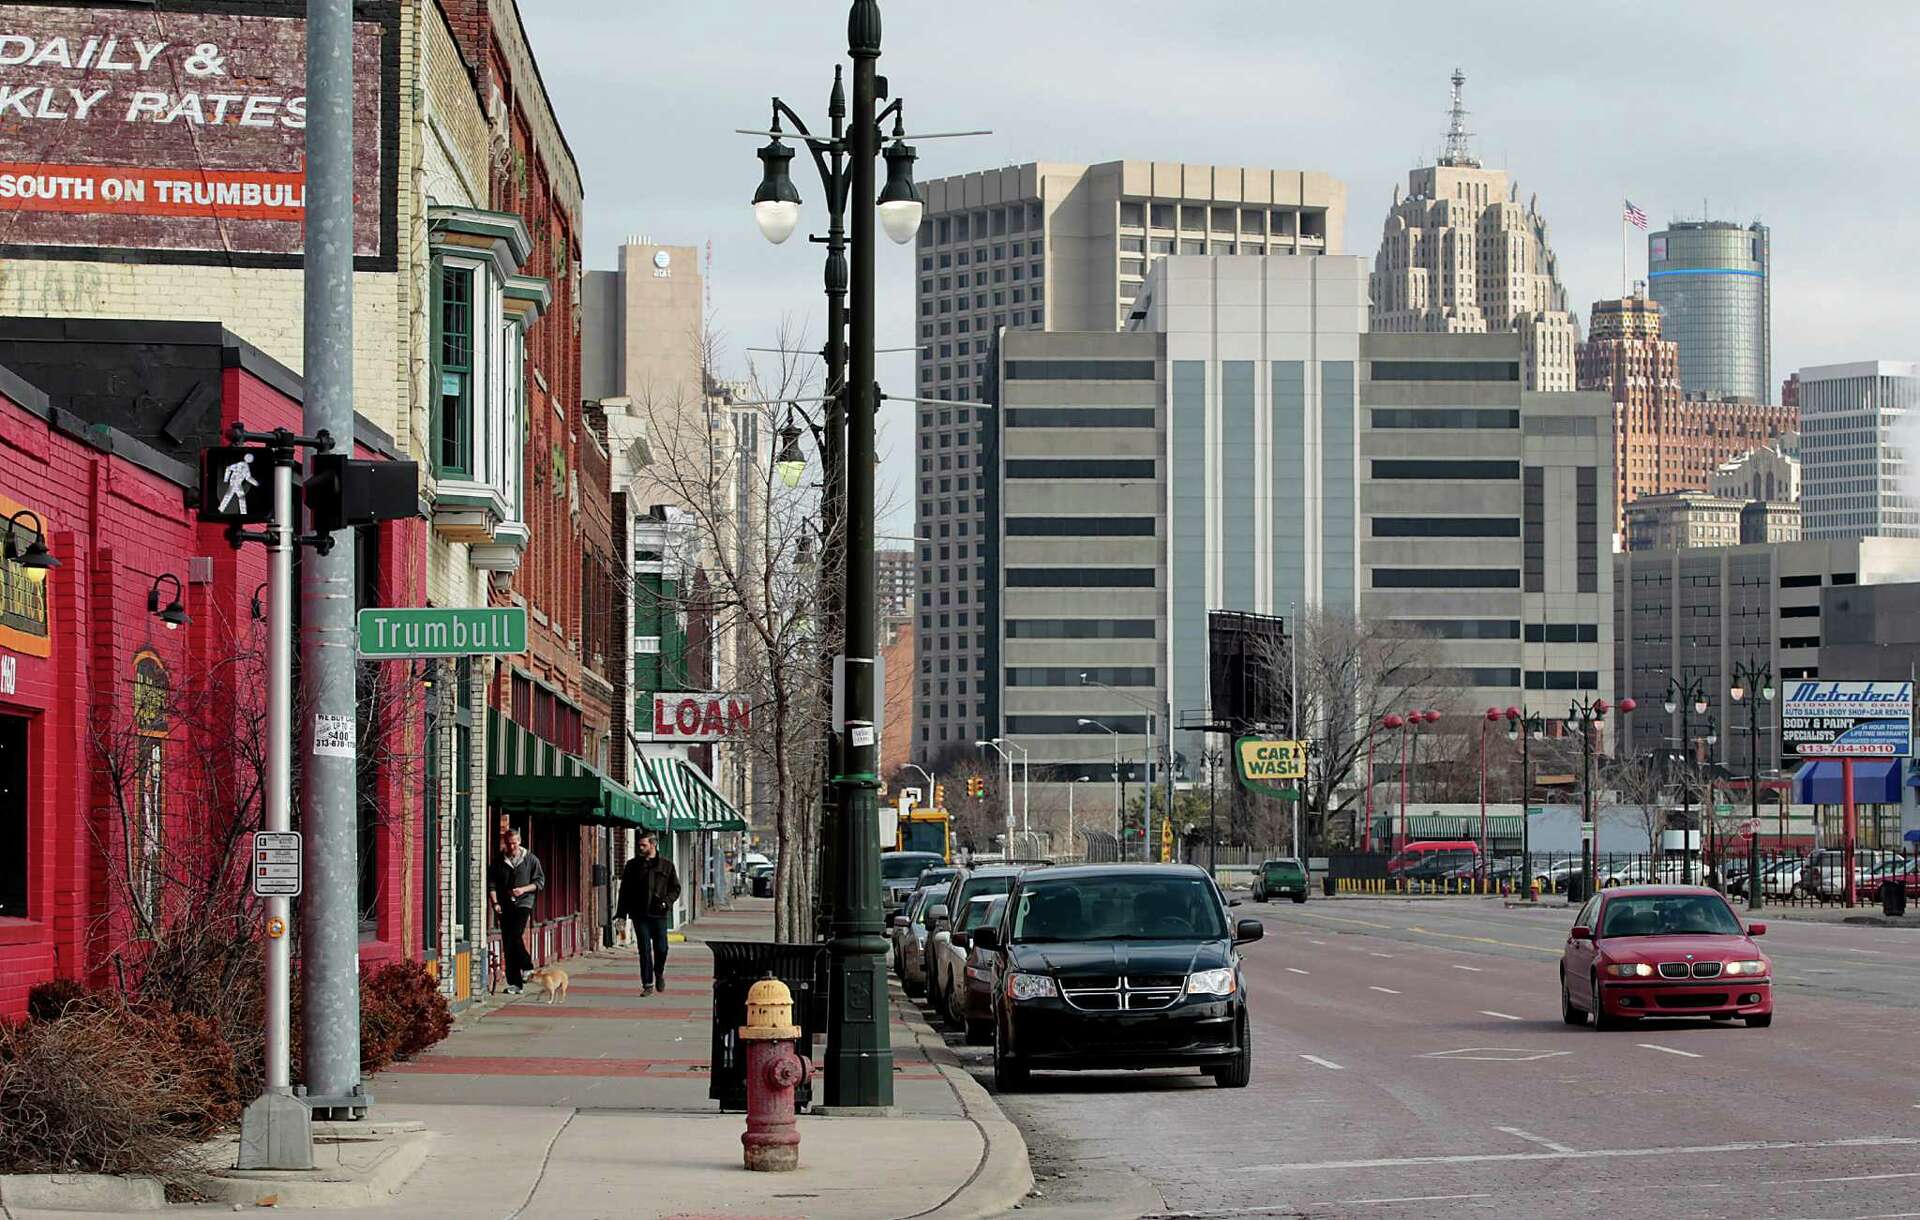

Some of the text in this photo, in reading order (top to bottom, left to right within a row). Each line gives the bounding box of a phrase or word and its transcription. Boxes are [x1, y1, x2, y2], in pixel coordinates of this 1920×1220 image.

[0, 35, 226, 77] DAILY &
[125, 91, 306, 128] RATES
[0, 174, 305, 207] SOUTH ON TRUMBUL
[374, 614, 511, 648] Trumbull
[1786, 682, 1910, 702] Metrotech
[655, 698, 750, 736] LOAN
[1785, 708, 1910, 716] AUTO SALES BODY SHOP CAR RENTAL
[1783, 718, 1855, 729] BODY & PAINT
[1783, 730, 1836, 741] SPECIALISTS
[1256, 747, 1290, 760] CAR
[1248, 761, 1299, 774] WASH
